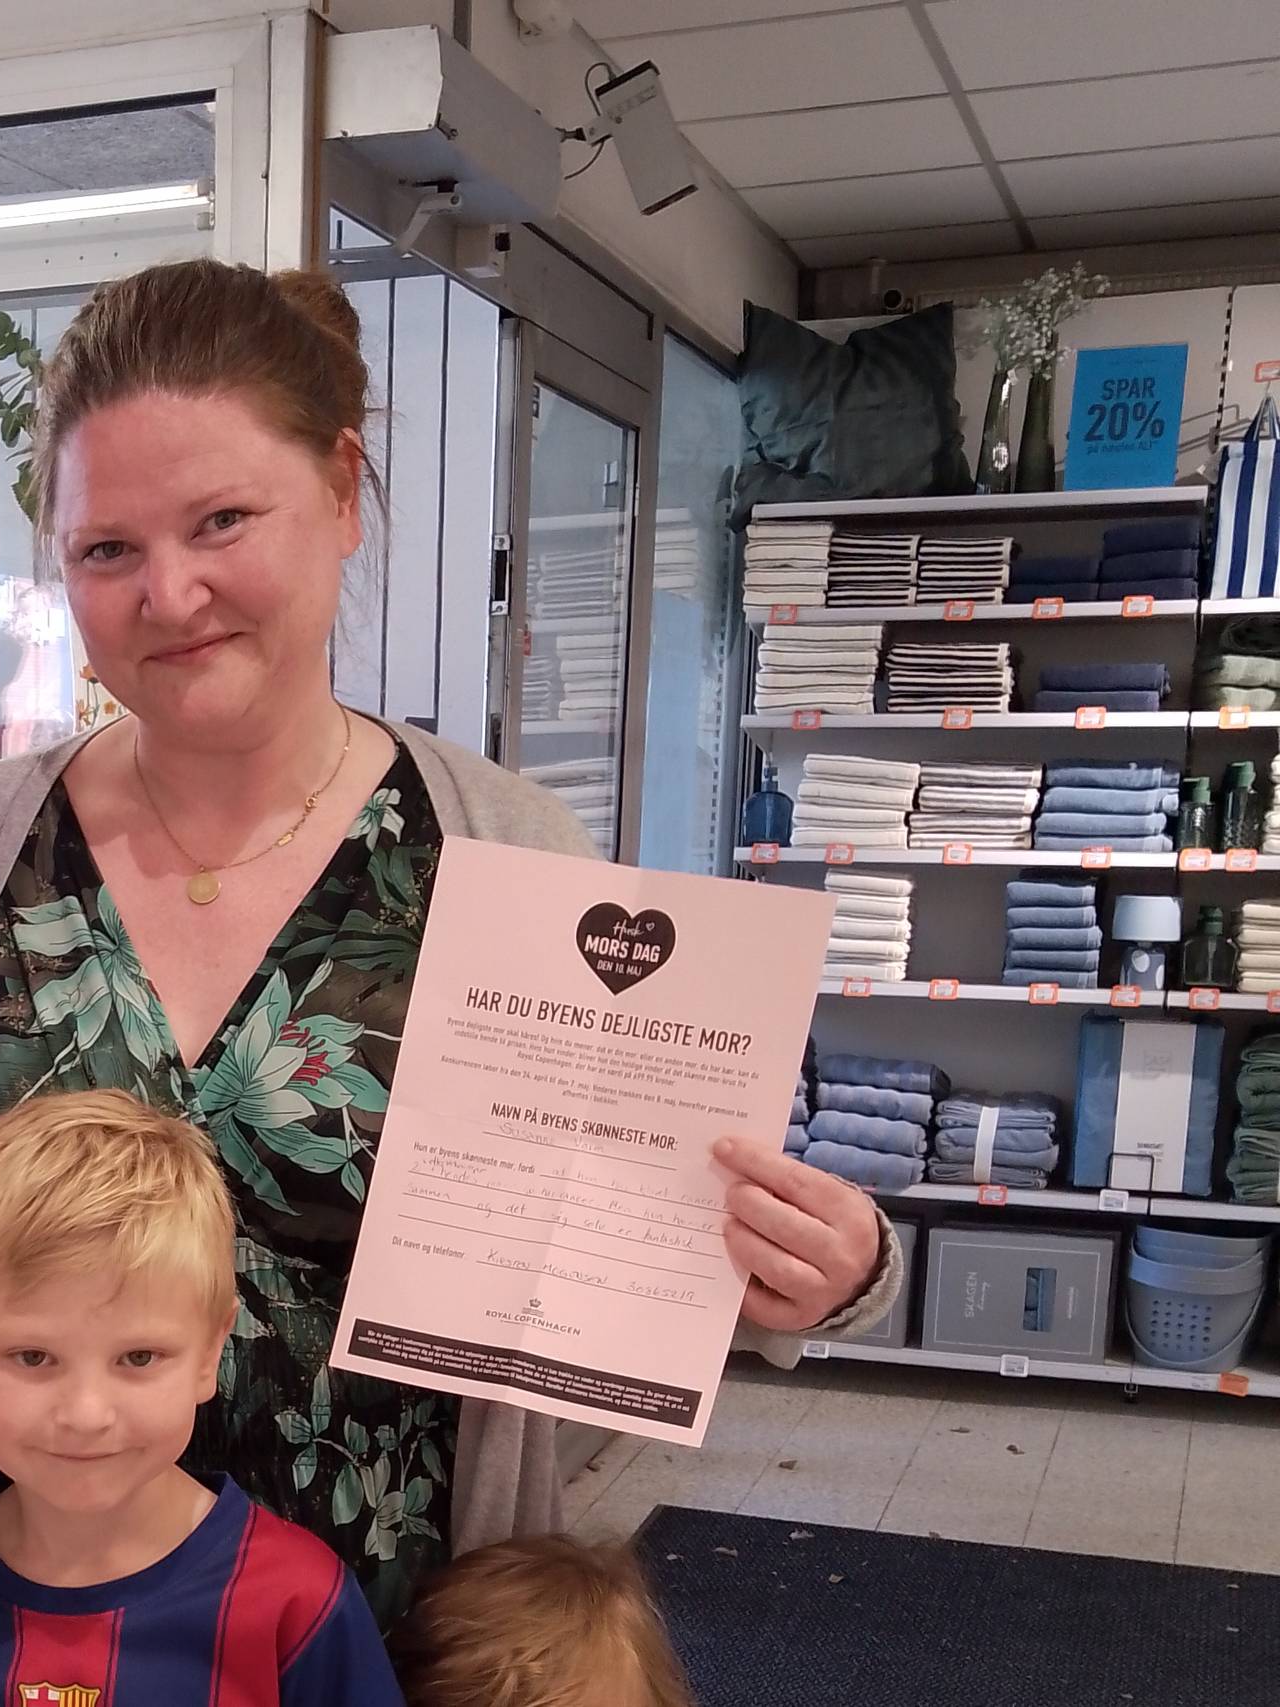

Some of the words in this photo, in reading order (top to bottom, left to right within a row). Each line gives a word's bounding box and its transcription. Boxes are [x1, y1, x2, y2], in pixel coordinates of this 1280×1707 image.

[1101, 376, 1156, 401] SPAR
[1083, 400, 1166, 442] 20%
[584, 934, 629, 958] MORS
[632, 942, 661, 963] DAG
[597, 959, 613, 972] DEN
[626, 965, 642, 977] MAJ
[466, 986, 502, 1013] HAR
[506, 994, 533, 1018] DU
[537, 1000, 597, 1030] BYENS
[600, 1012, 695, 1046] DEJLIGSTE
[698, 1027, 752, 1056] MOR?
[491, 1102, 521, 1121] NAVN
[523, 1107, 537, 1124] PÅ
[541, 1111, 578, 1132] BYENS
[580, 1120, 648, 1145] SKØNNESTE
[649, 1132, 679, 1151] MOR:
[413, 1141, 428, 1153] Hun
[430, 1145, 438, 1154] er
[438, 1146, 460, 1160] byens
[462, 1150, 497, 1167] skønneste
[518, 1162, 535, 1174] fordi
[404, 1239, 421, 1251] navn
[422, 1244, 431, 1255] og
[485, 1309, 512, 1321] ROYAL
[514, 1314, 582, 1337] COPENHAGEN
